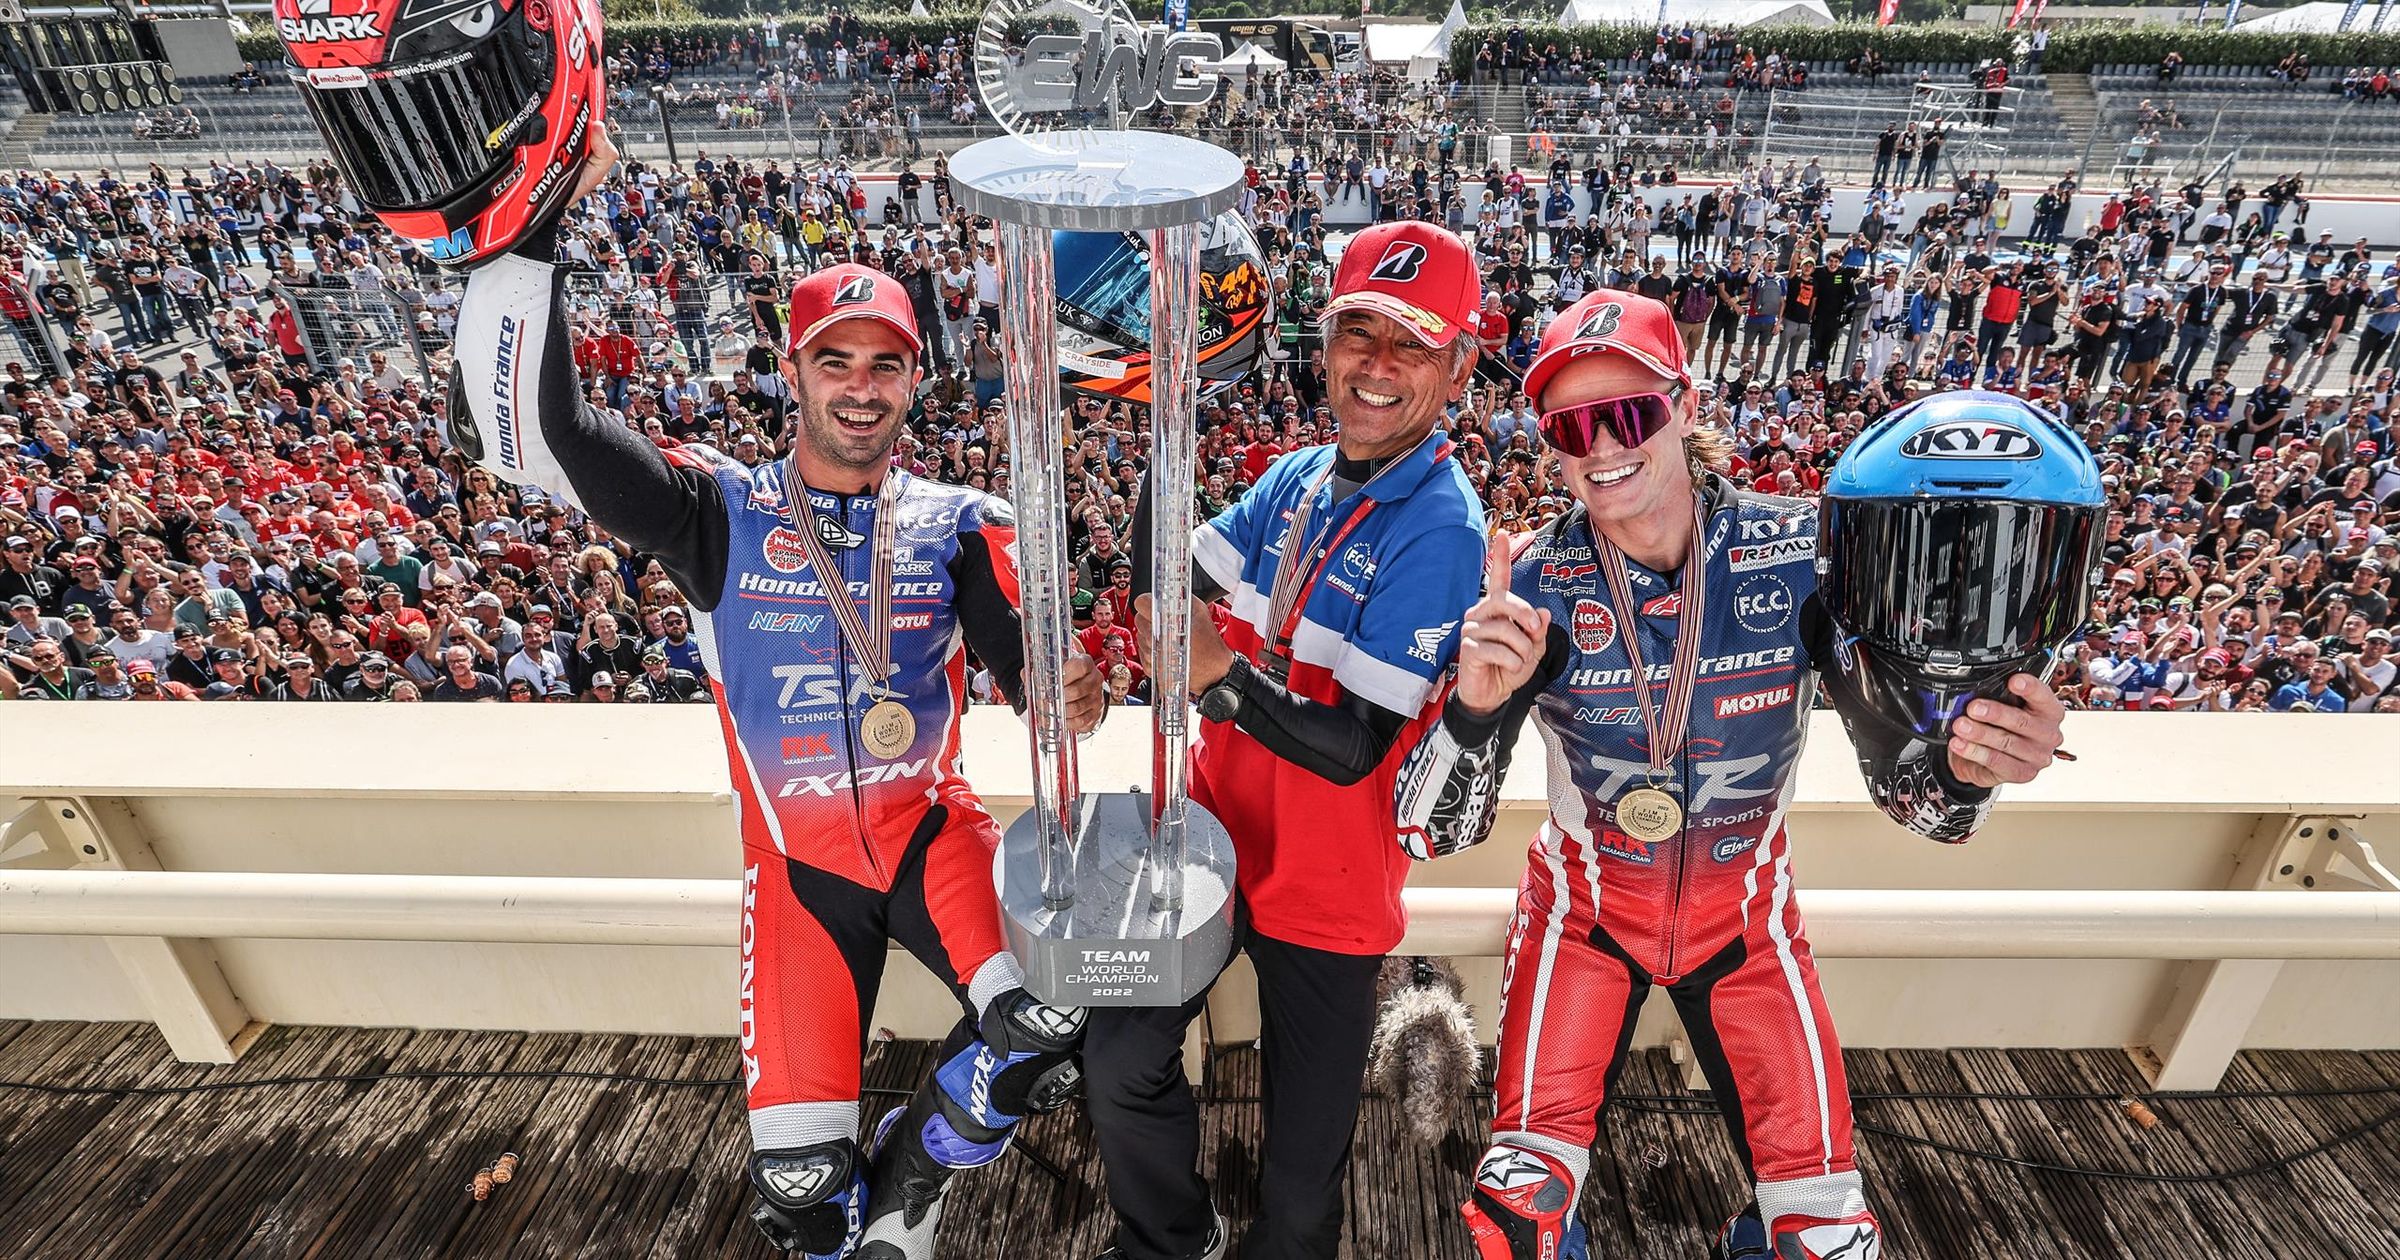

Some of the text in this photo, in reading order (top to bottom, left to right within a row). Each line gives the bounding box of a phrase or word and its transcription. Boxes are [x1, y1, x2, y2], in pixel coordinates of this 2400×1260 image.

[281, 14, 384, 43] SHARK
[1021, 29, 1223, 107] EWC
[1198, 325, 1224, 344] ION
[1064, 351, 1113, 369] CRAYSIDE
[493, 314, 516, 470] Honda France
[1916, 428, 2028, 456] KYT
[1742, 539, 1815, 561] REMU
[847, 581, 943, 597] Frnce
[1739, 590, 1789, 616] F.C.C.
[891, 614, 931, 630] OTUL
[1580, 628, 1606, 637] PARK
[1697, 646, 1795, 675] rance
[1718, 687, 1792, 717] MOTUL
[781, 732, 834, 760] RK
[1590, 752, 1777, 814] TR
[1701, 806, 1765, 829] SPORTS
[1602, 830, 1652, 857] RK
[1720, 837, 1757, 857] EWC
[1080, 950, 1151, 963] TEAM
[740, 863, 761, 1098] HONDA
[1065, 974, 1160, 984] CHAMPION
[1081, 965, 1146, 975] WORLD
[1092, 988, 1134, 996] 2022
